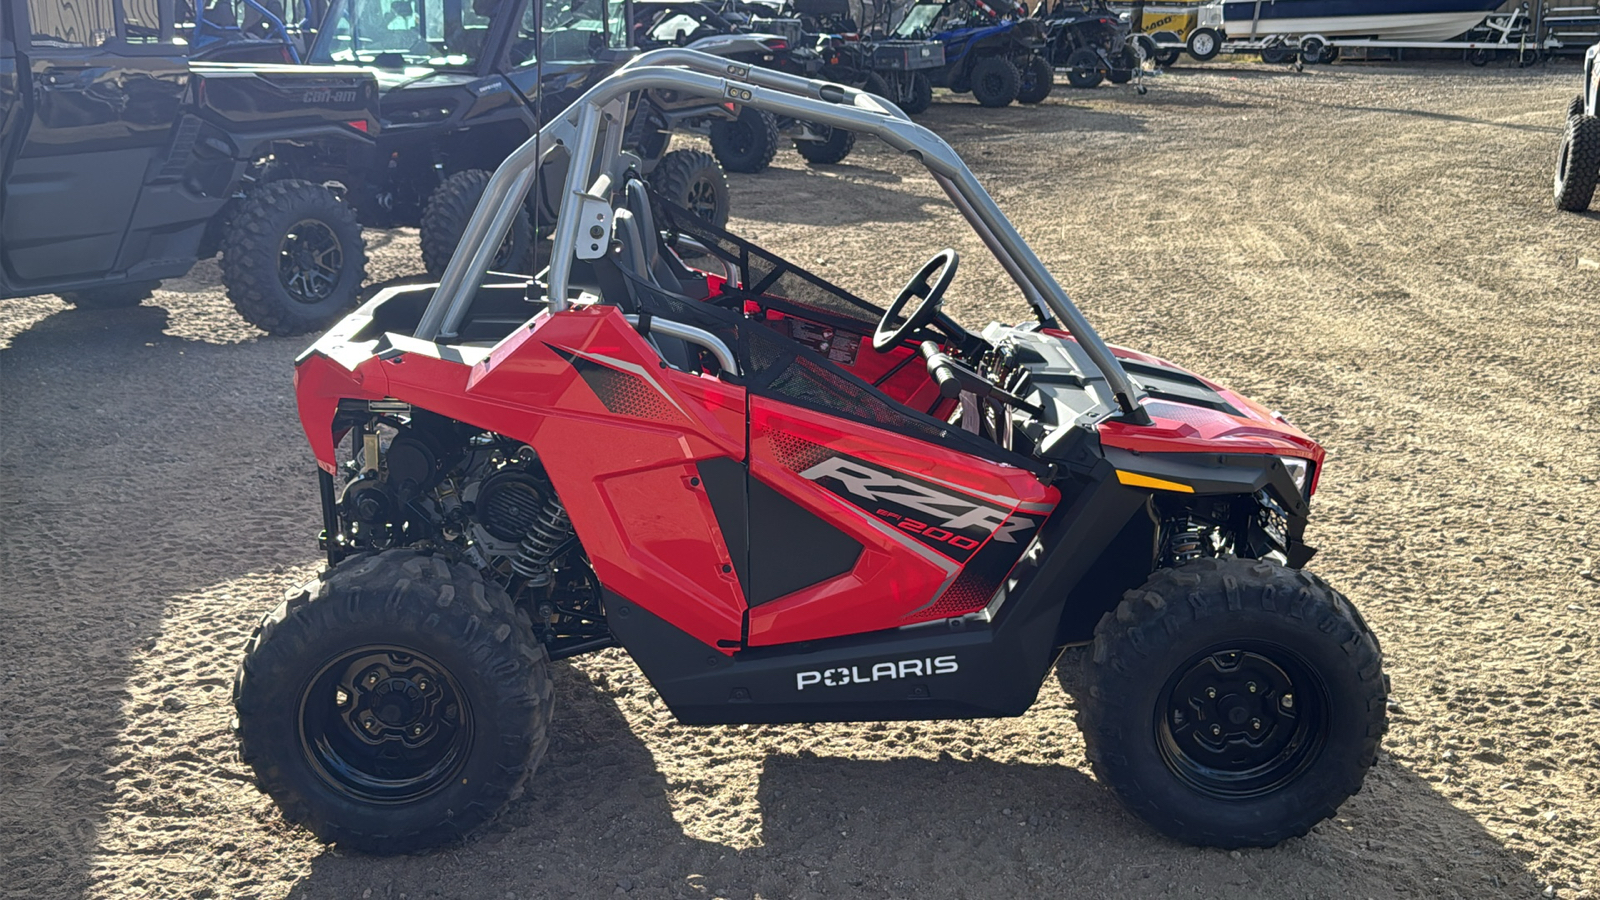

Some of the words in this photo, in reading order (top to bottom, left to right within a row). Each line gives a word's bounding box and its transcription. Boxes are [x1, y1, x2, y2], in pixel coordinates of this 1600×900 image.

[799, 457, 1036, 543] RZR
[897, 517, 980, 550] 200
[797, 655, 959, 690] POLARIS
